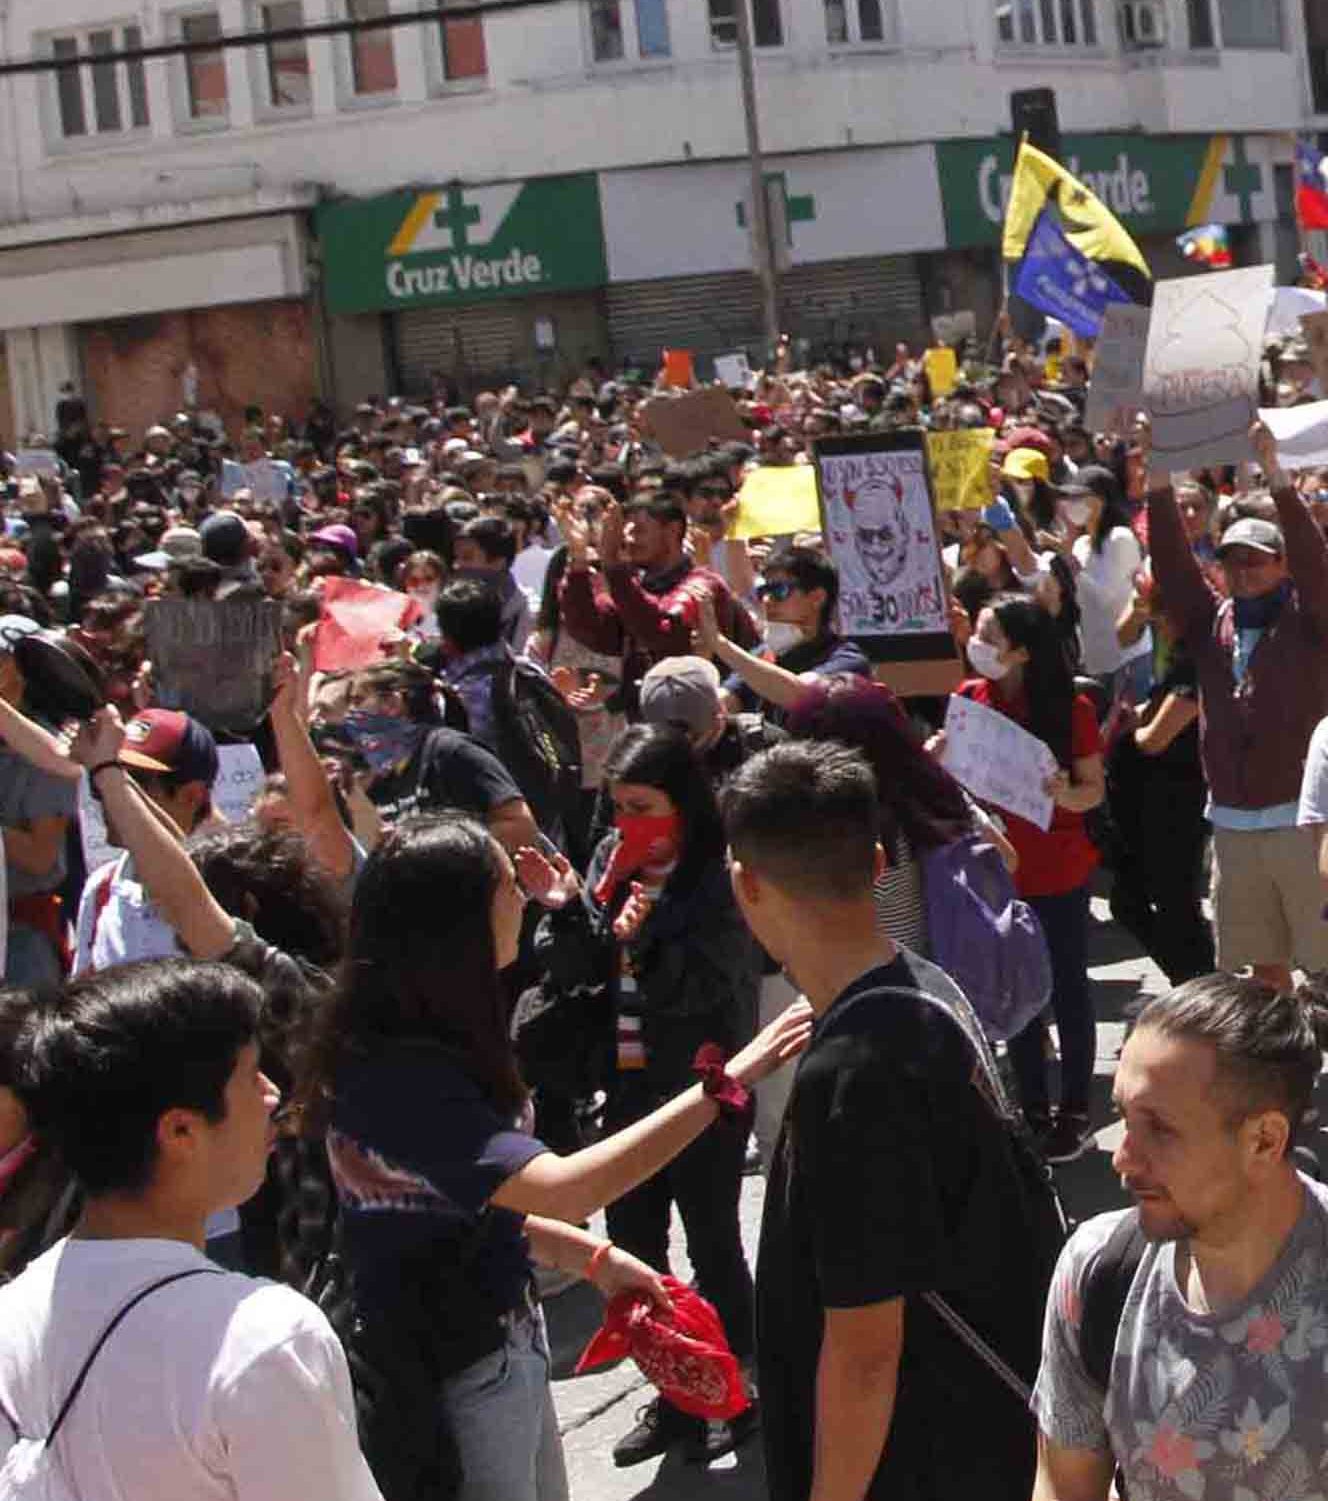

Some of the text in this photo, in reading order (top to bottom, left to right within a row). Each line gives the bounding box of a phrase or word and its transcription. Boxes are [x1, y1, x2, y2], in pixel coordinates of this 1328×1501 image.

[386, 247, 542, 297] Cruz Verde
[868, 589, 897, 623] 30
